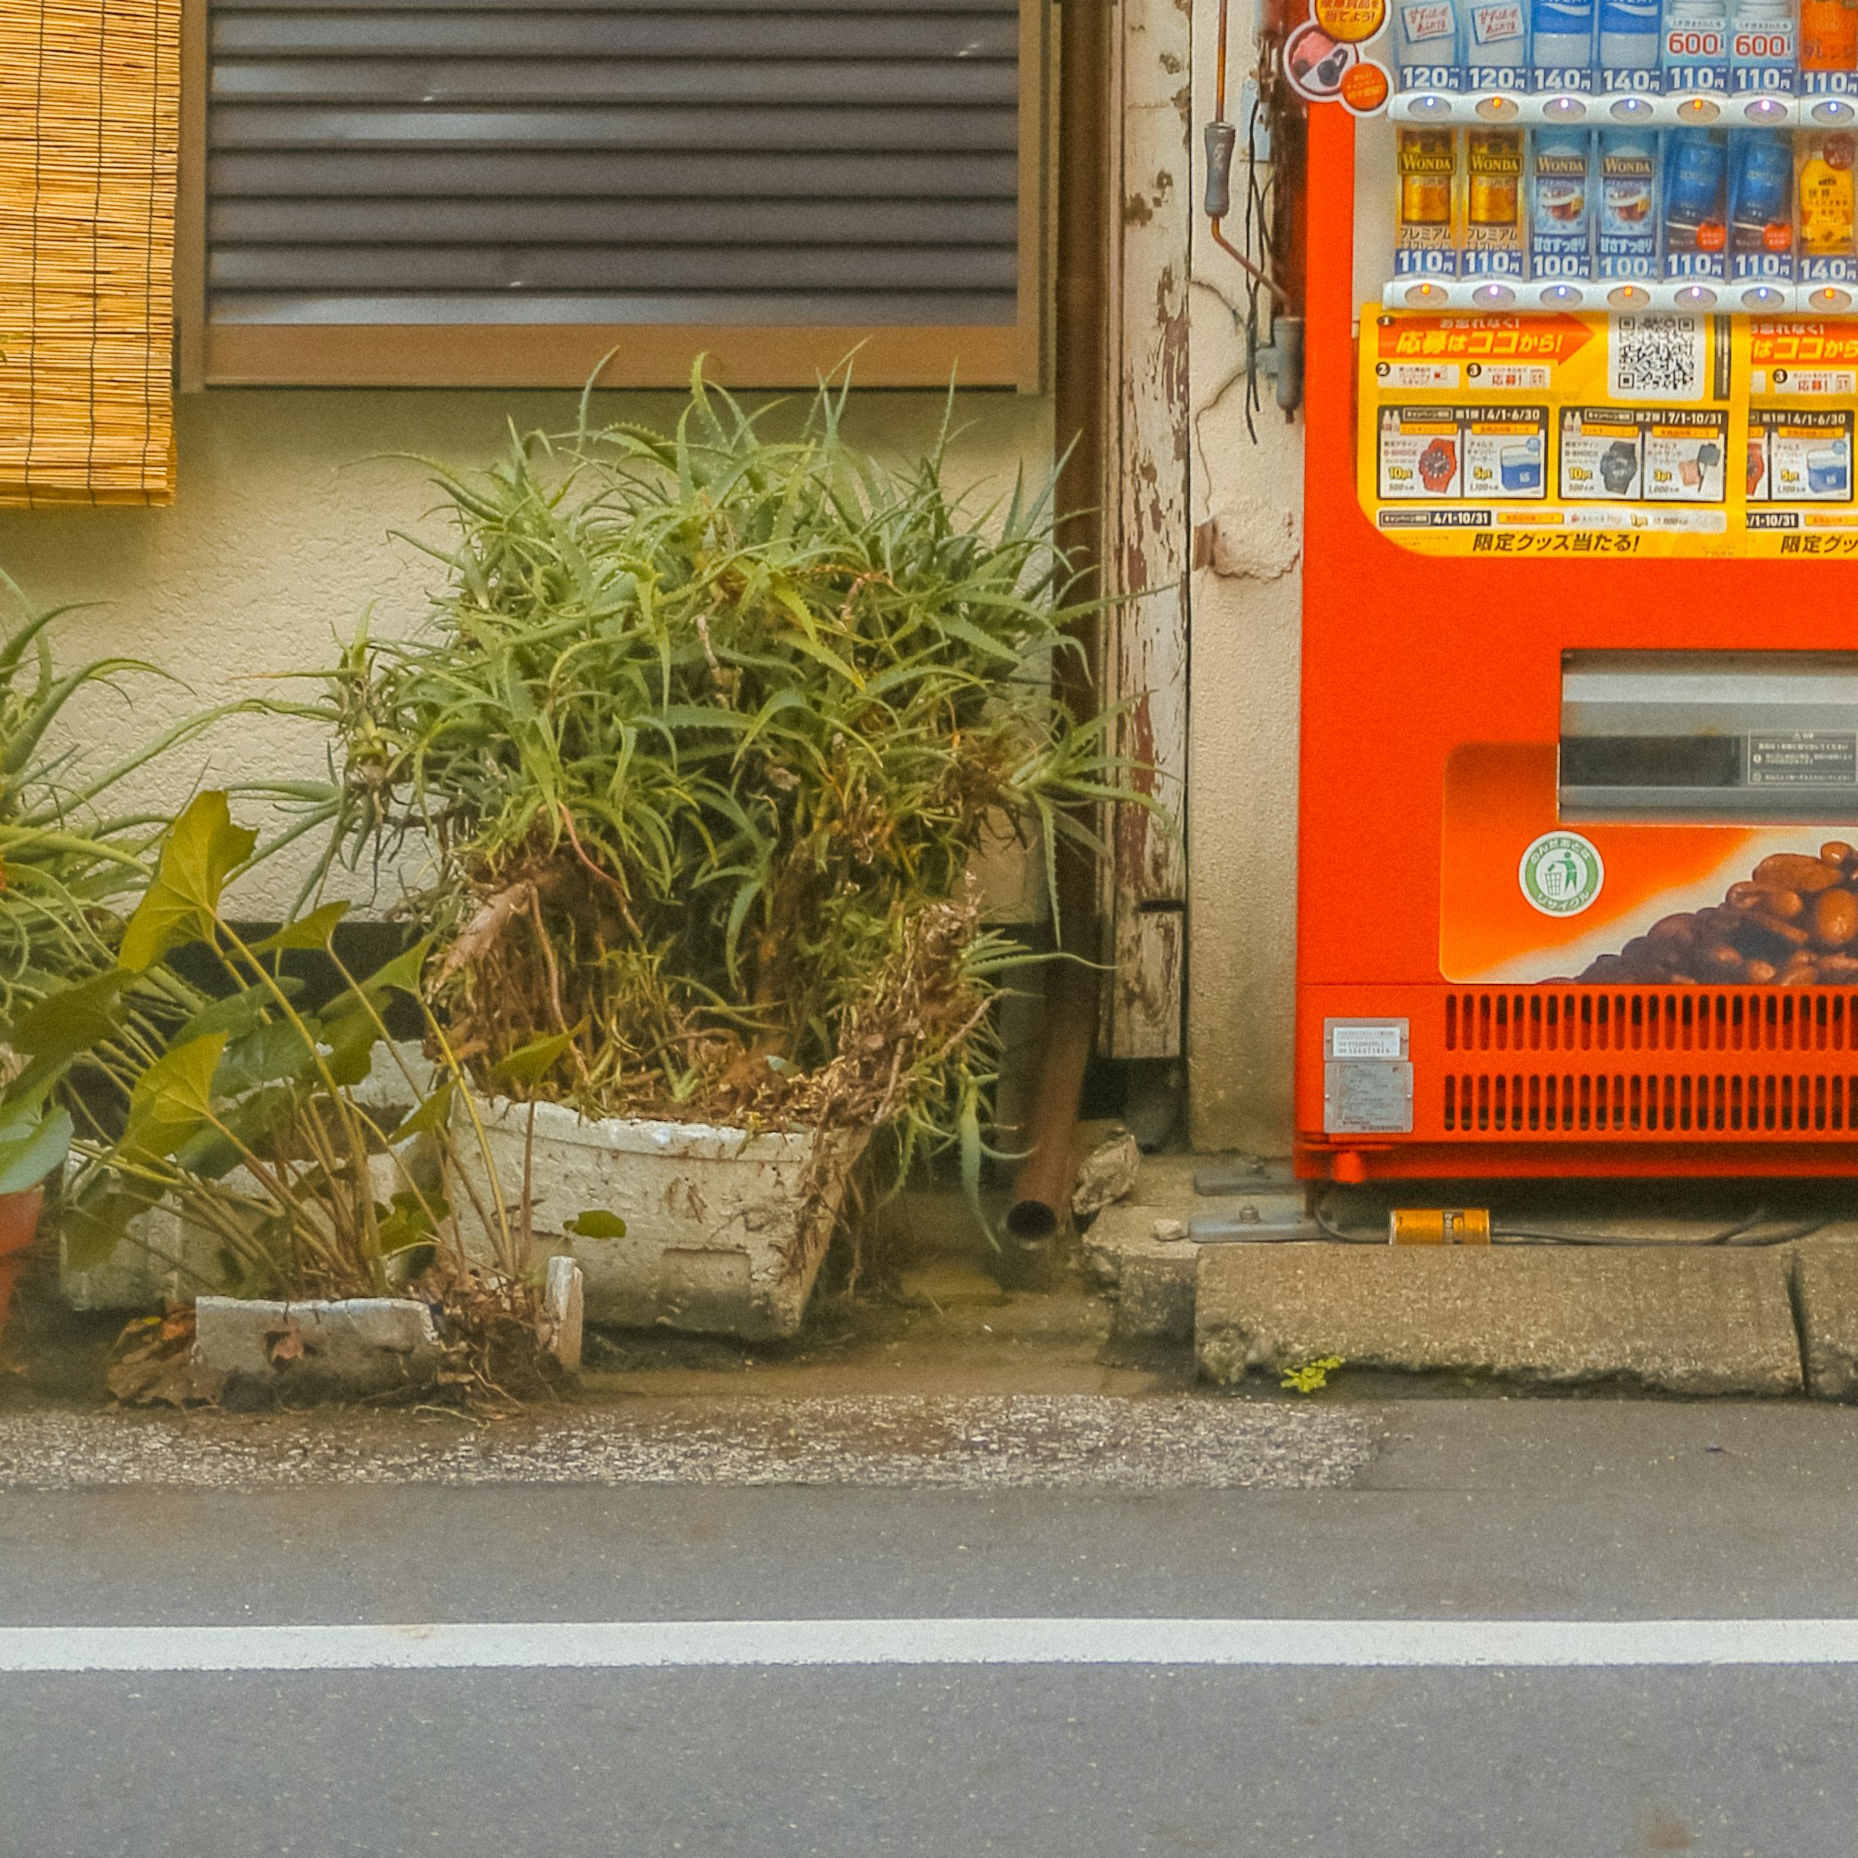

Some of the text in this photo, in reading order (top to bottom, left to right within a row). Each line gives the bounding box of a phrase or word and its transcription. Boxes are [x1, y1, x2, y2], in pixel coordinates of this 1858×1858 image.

[1668, 32, 1718, 55] 600
[1735, 34, 1785, 57] 600
[1402, 154, 1451, 170] WONDA
[1472, 154, 1519, 171] WONDA
[1537, 156, 1584, 172] WONDA
[1604, 157, 1651, 173] WONDA
[1396, 331, 1563, 355] 応募はココから!
[1472, 533, 1641, 552] 限定グッズ当たる!
